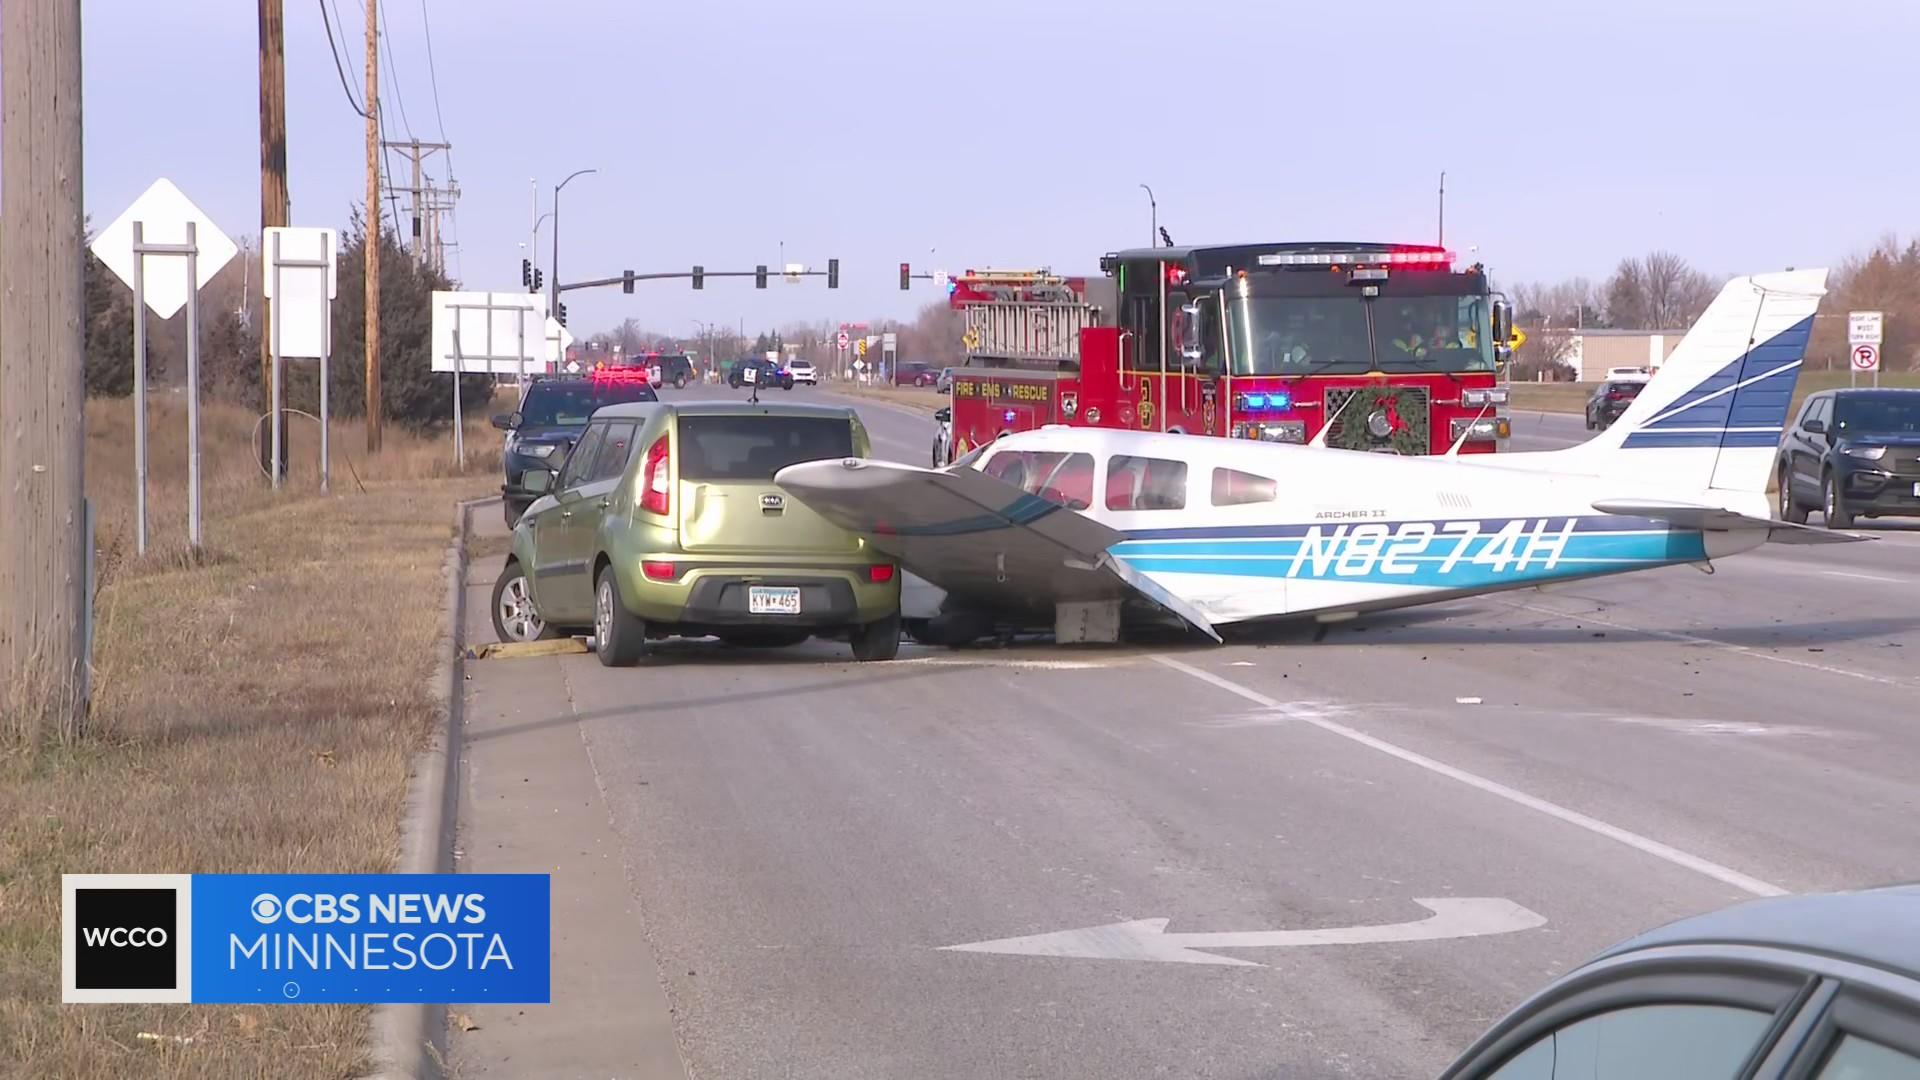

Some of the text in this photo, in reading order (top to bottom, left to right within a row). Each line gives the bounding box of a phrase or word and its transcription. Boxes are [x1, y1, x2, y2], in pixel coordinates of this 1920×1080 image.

[955, 381, 1047, 400] FIRE EMS RESCUE
[1315, 511, 1368, 519] ARCHER
[1286, 518, 1578, 577] N8274H
